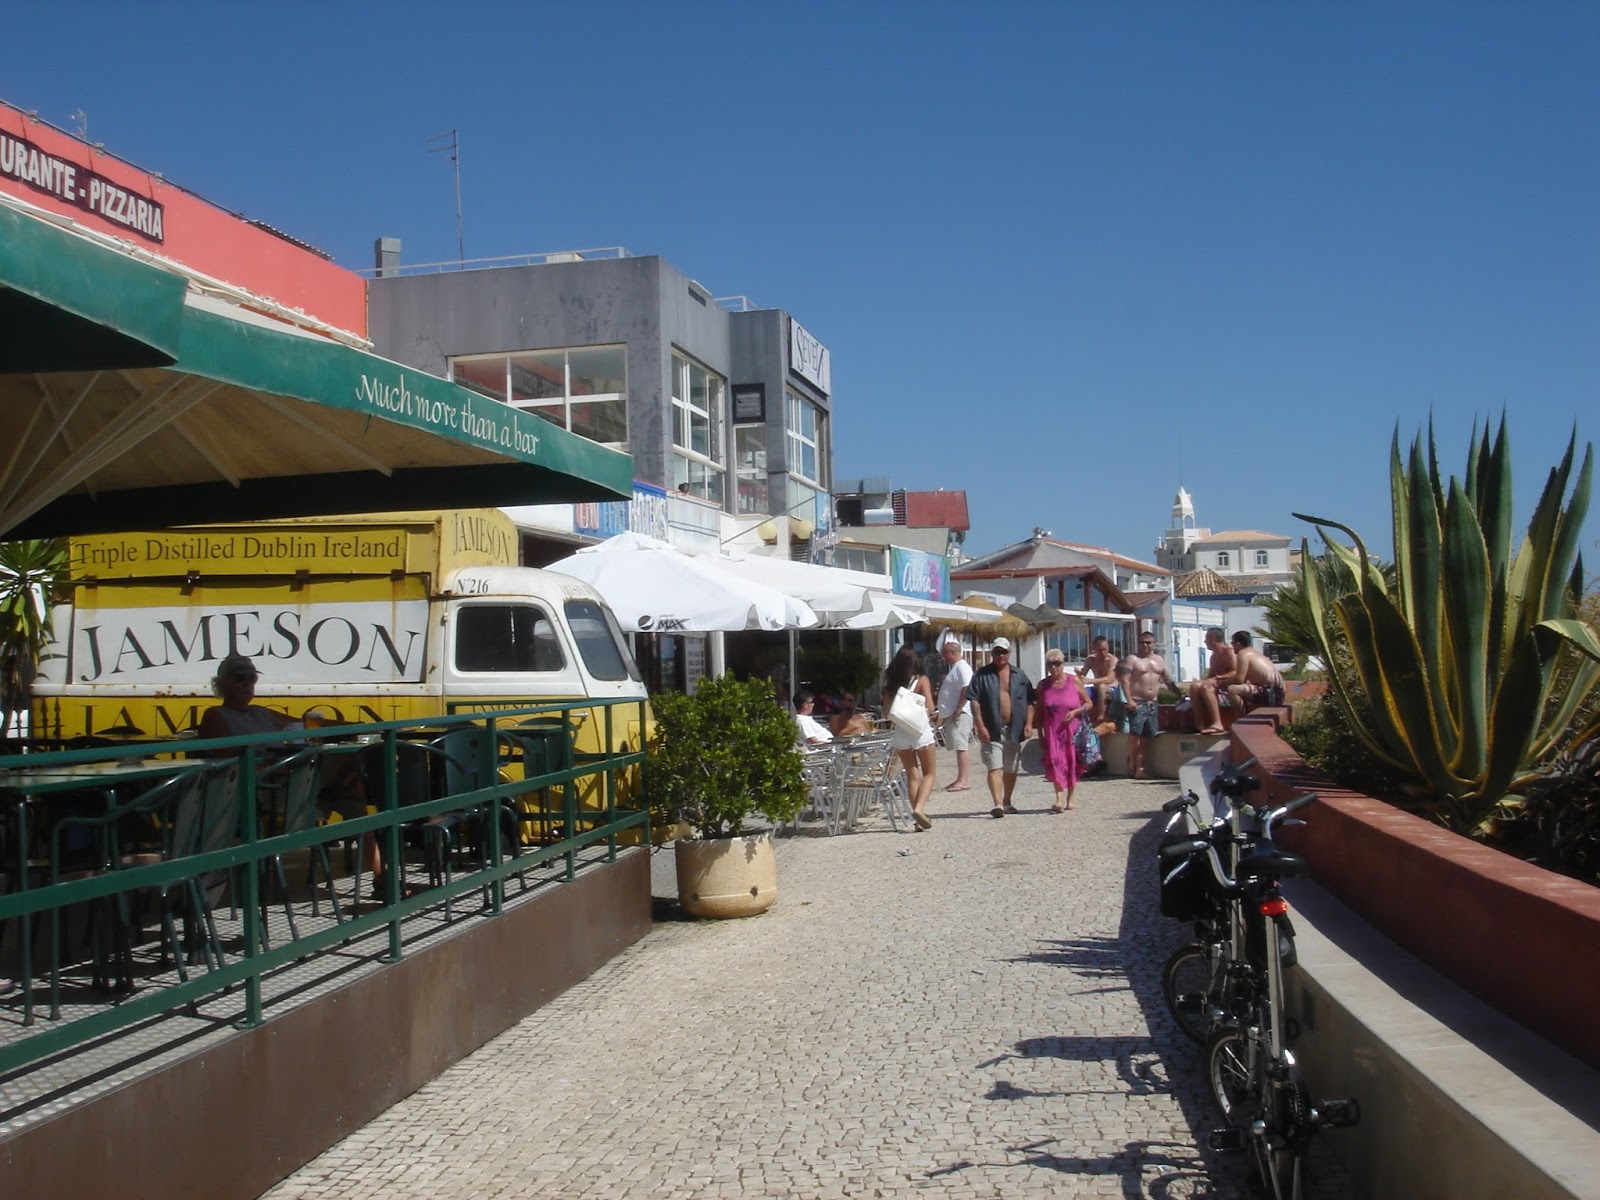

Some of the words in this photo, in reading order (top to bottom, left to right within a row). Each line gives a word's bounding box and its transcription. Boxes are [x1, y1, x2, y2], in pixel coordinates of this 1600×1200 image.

[0, 135, 76, 201] URANTE
[89, 177, 163, 240] PIZZARIA
[355, 374, 413, 416] Much
[415, 395, 458, 429] more
[461, 398, 498, 443] than
[514, 415, 540, 456] bar
[75, 542, 138, 570] Triple
[145, 537, 235, 561] Distilled
[242, 536, 317, 559] Dublin
[323, 535, 401, 559] Ireland
[453, 513, 511, 566] JAMESON
[81, 610, 422, 682] JAMESON
[655, 618, 691, 631] MAX
